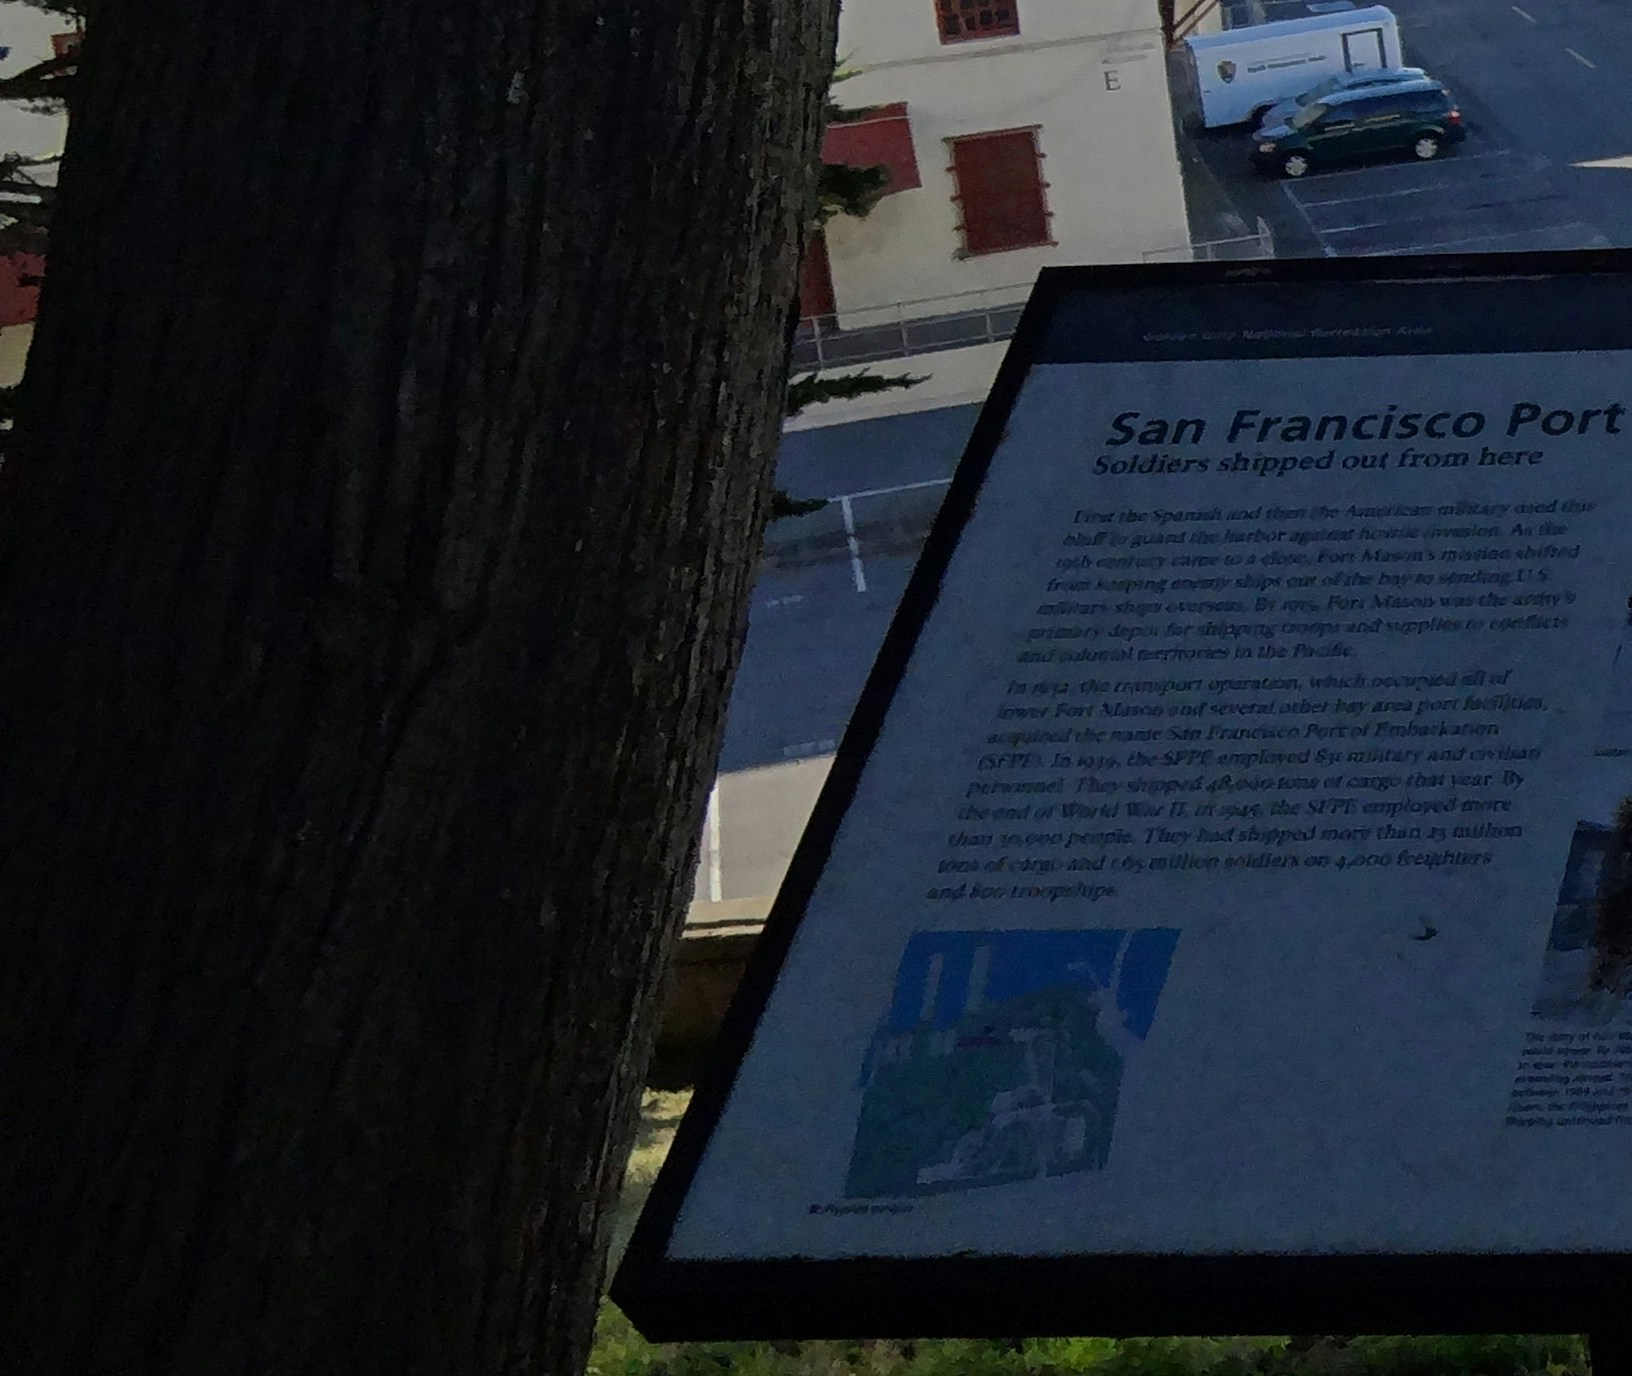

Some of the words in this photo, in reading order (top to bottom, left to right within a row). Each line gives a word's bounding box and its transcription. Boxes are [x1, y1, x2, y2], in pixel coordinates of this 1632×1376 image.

[1103, 70, 1121, 91] E
[1105, 411, 1206, 446] San
[1226, 404, 1486, 443] Francisco
[1506, 402, 1626, 436] Port
[1092, 453, 1210, 475] Soldiers
[1216, 449, 1336, 477] shipped
[1341, 452, 1389, 470] out
[1397, 447, 1469, 468] from
[1478, 446, 1543, 466] here
